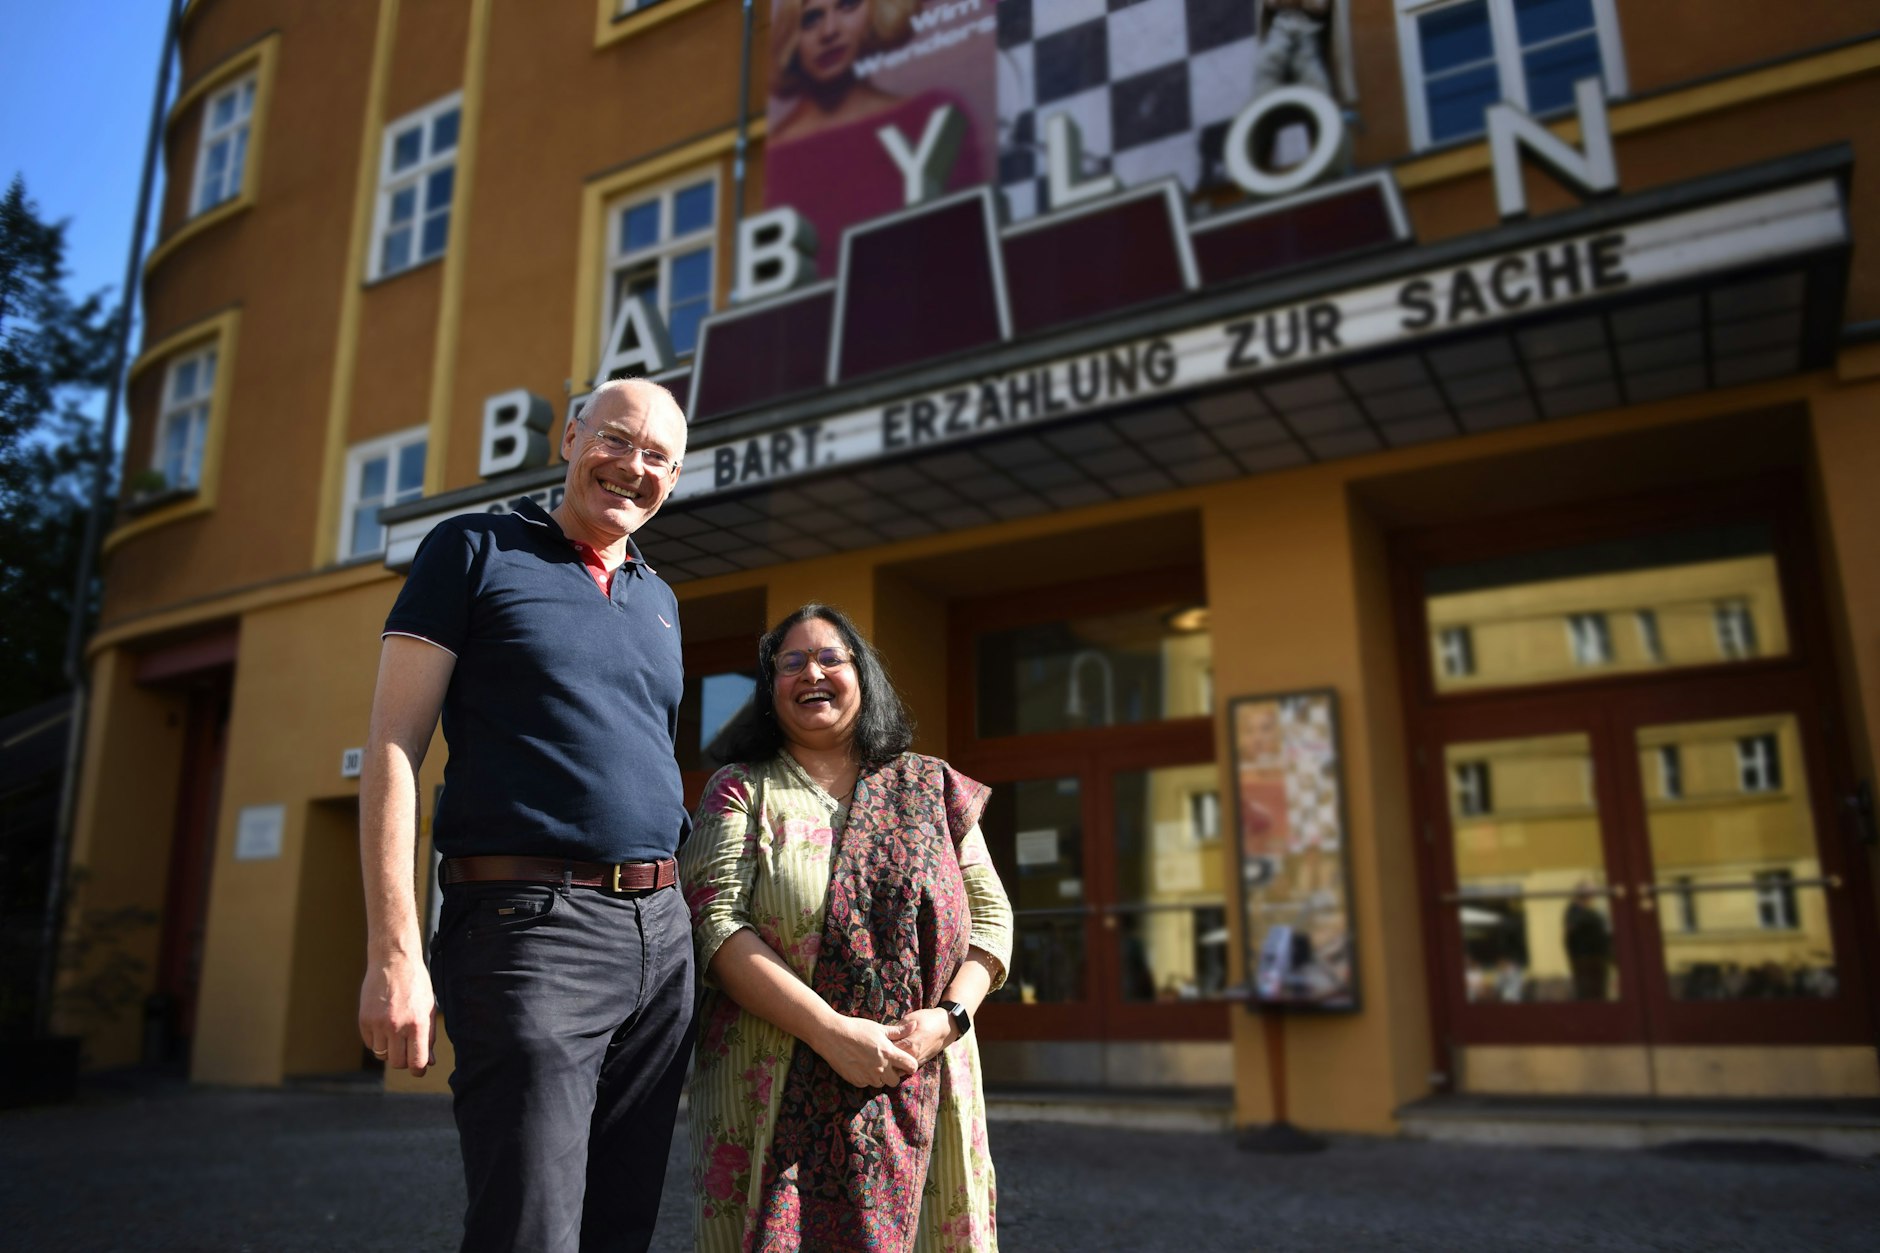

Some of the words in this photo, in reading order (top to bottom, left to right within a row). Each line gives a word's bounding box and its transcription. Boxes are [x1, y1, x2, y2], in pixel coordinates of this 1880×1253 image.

[714, 423, 836, 488] BART:
[1223, 301, 1343, 371] ZUR
[1398, 233, 1628, 330] SACHE
